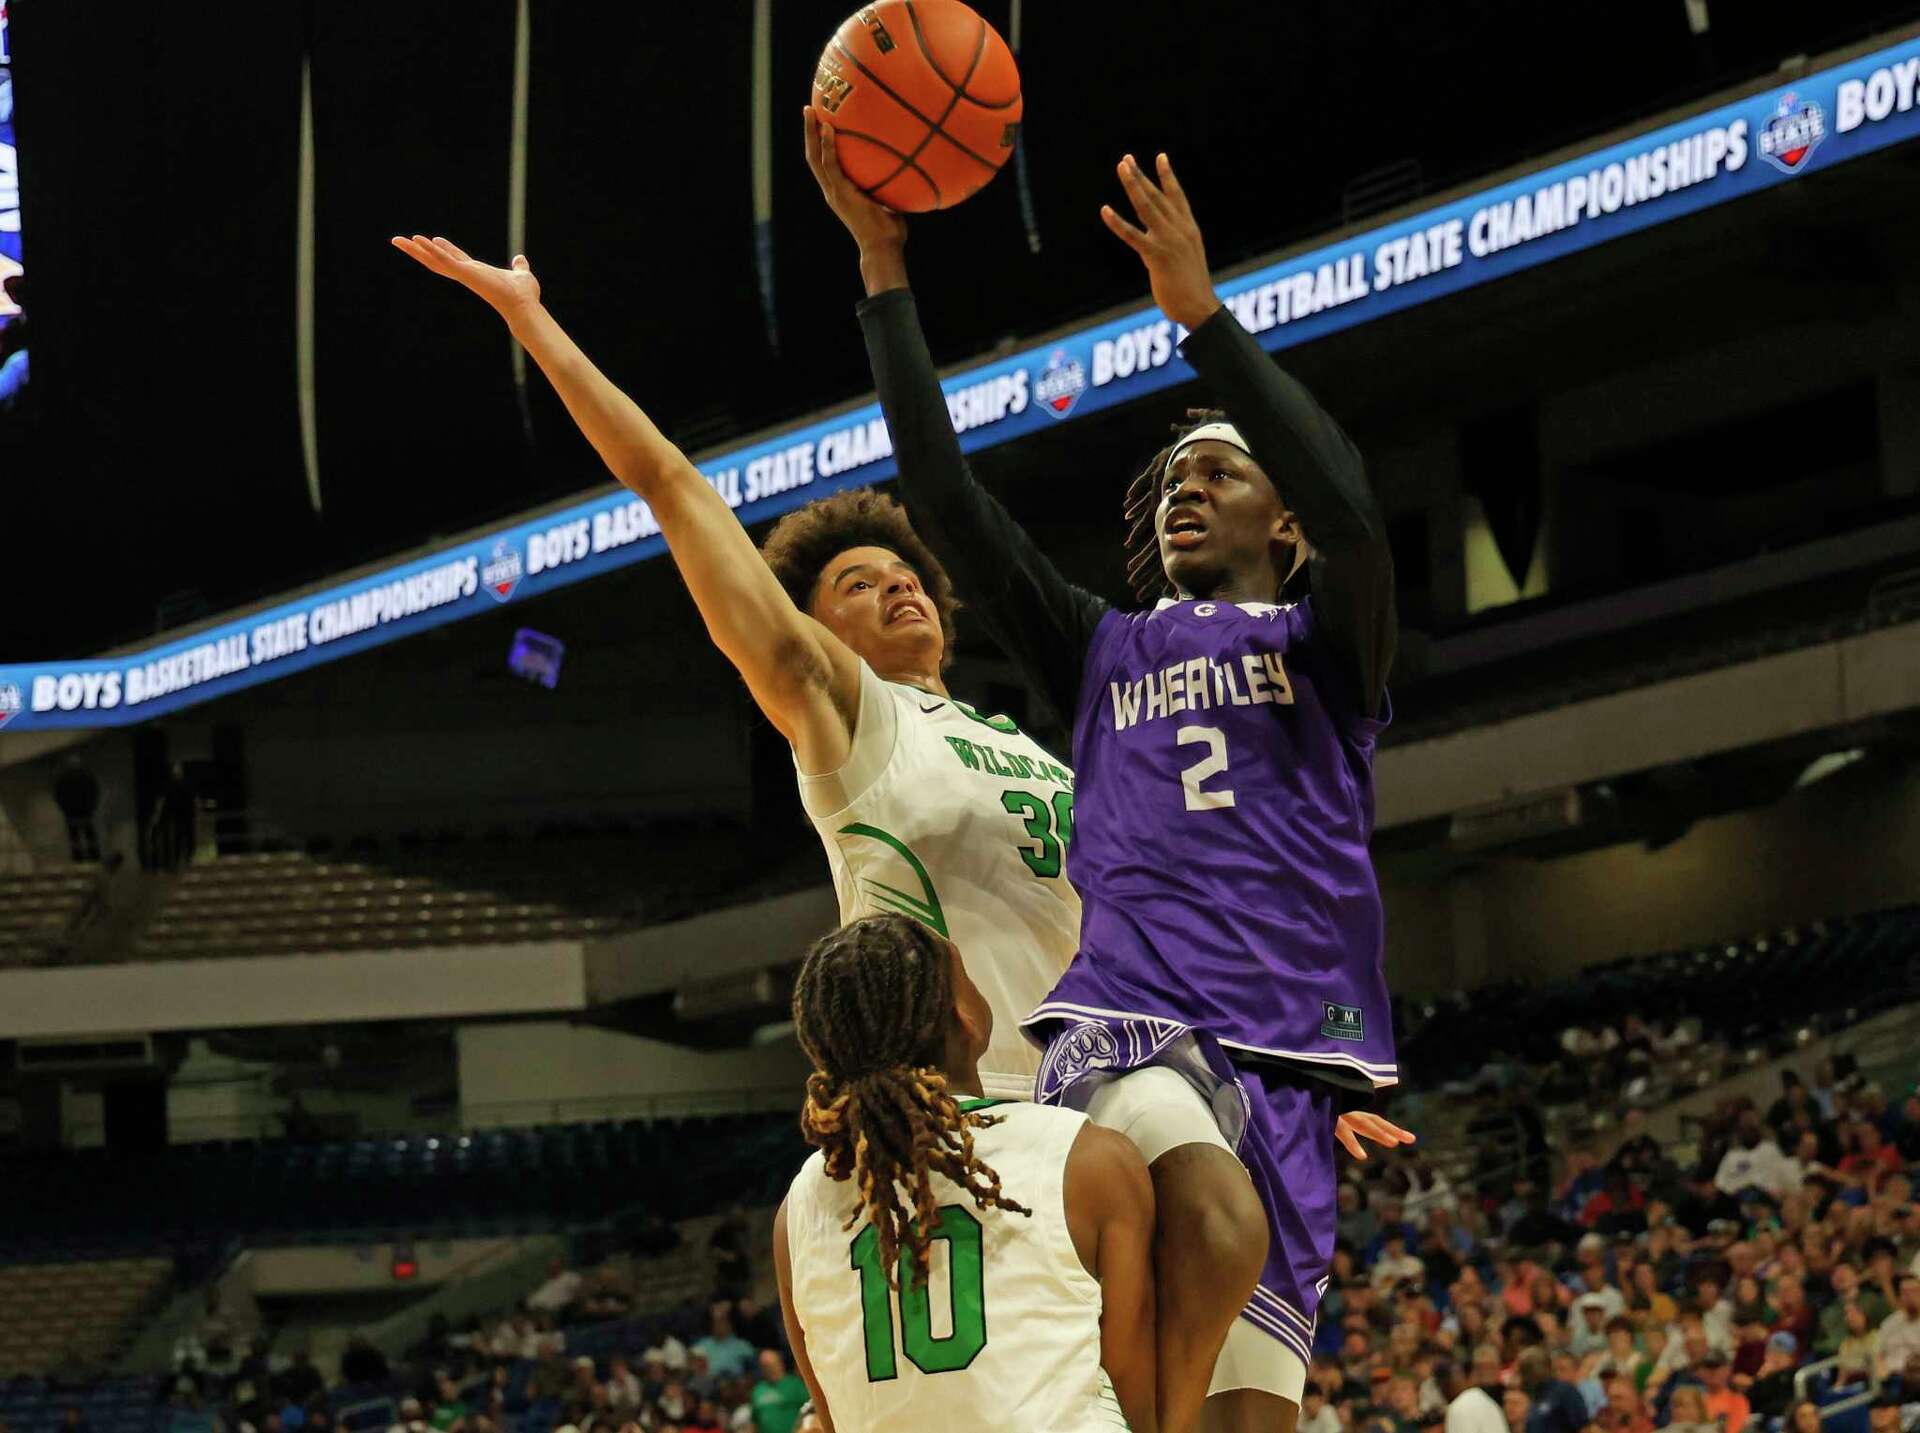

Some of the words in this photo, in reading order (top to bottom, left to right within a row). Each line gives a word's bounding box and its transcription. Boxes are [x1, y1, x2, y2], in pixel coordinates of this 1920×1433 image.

[1837, 56, 1920, 133] BOY
[1374, 209, 1463, 292] STATE
[1468, 118, 1748, 257] CHAMPIONSHIPS
[1092, 319, 1172, 387] BOYS
[744, 441, 815, 503] STATE
[526, 517, 590, 575] BOYS
[32, 671, 122, 712] BOYS
[124, 632, 250, 706] BASKETBALL
[252, 613, 308, 665] STATE
[308, 556, 478, 645] CHAMPIONSHIPS
[1110, 652, 1295, 731] WHEATLEY
[1176, 725, 1236, 812] 2
[849, 1203, 988, 1383] 10
